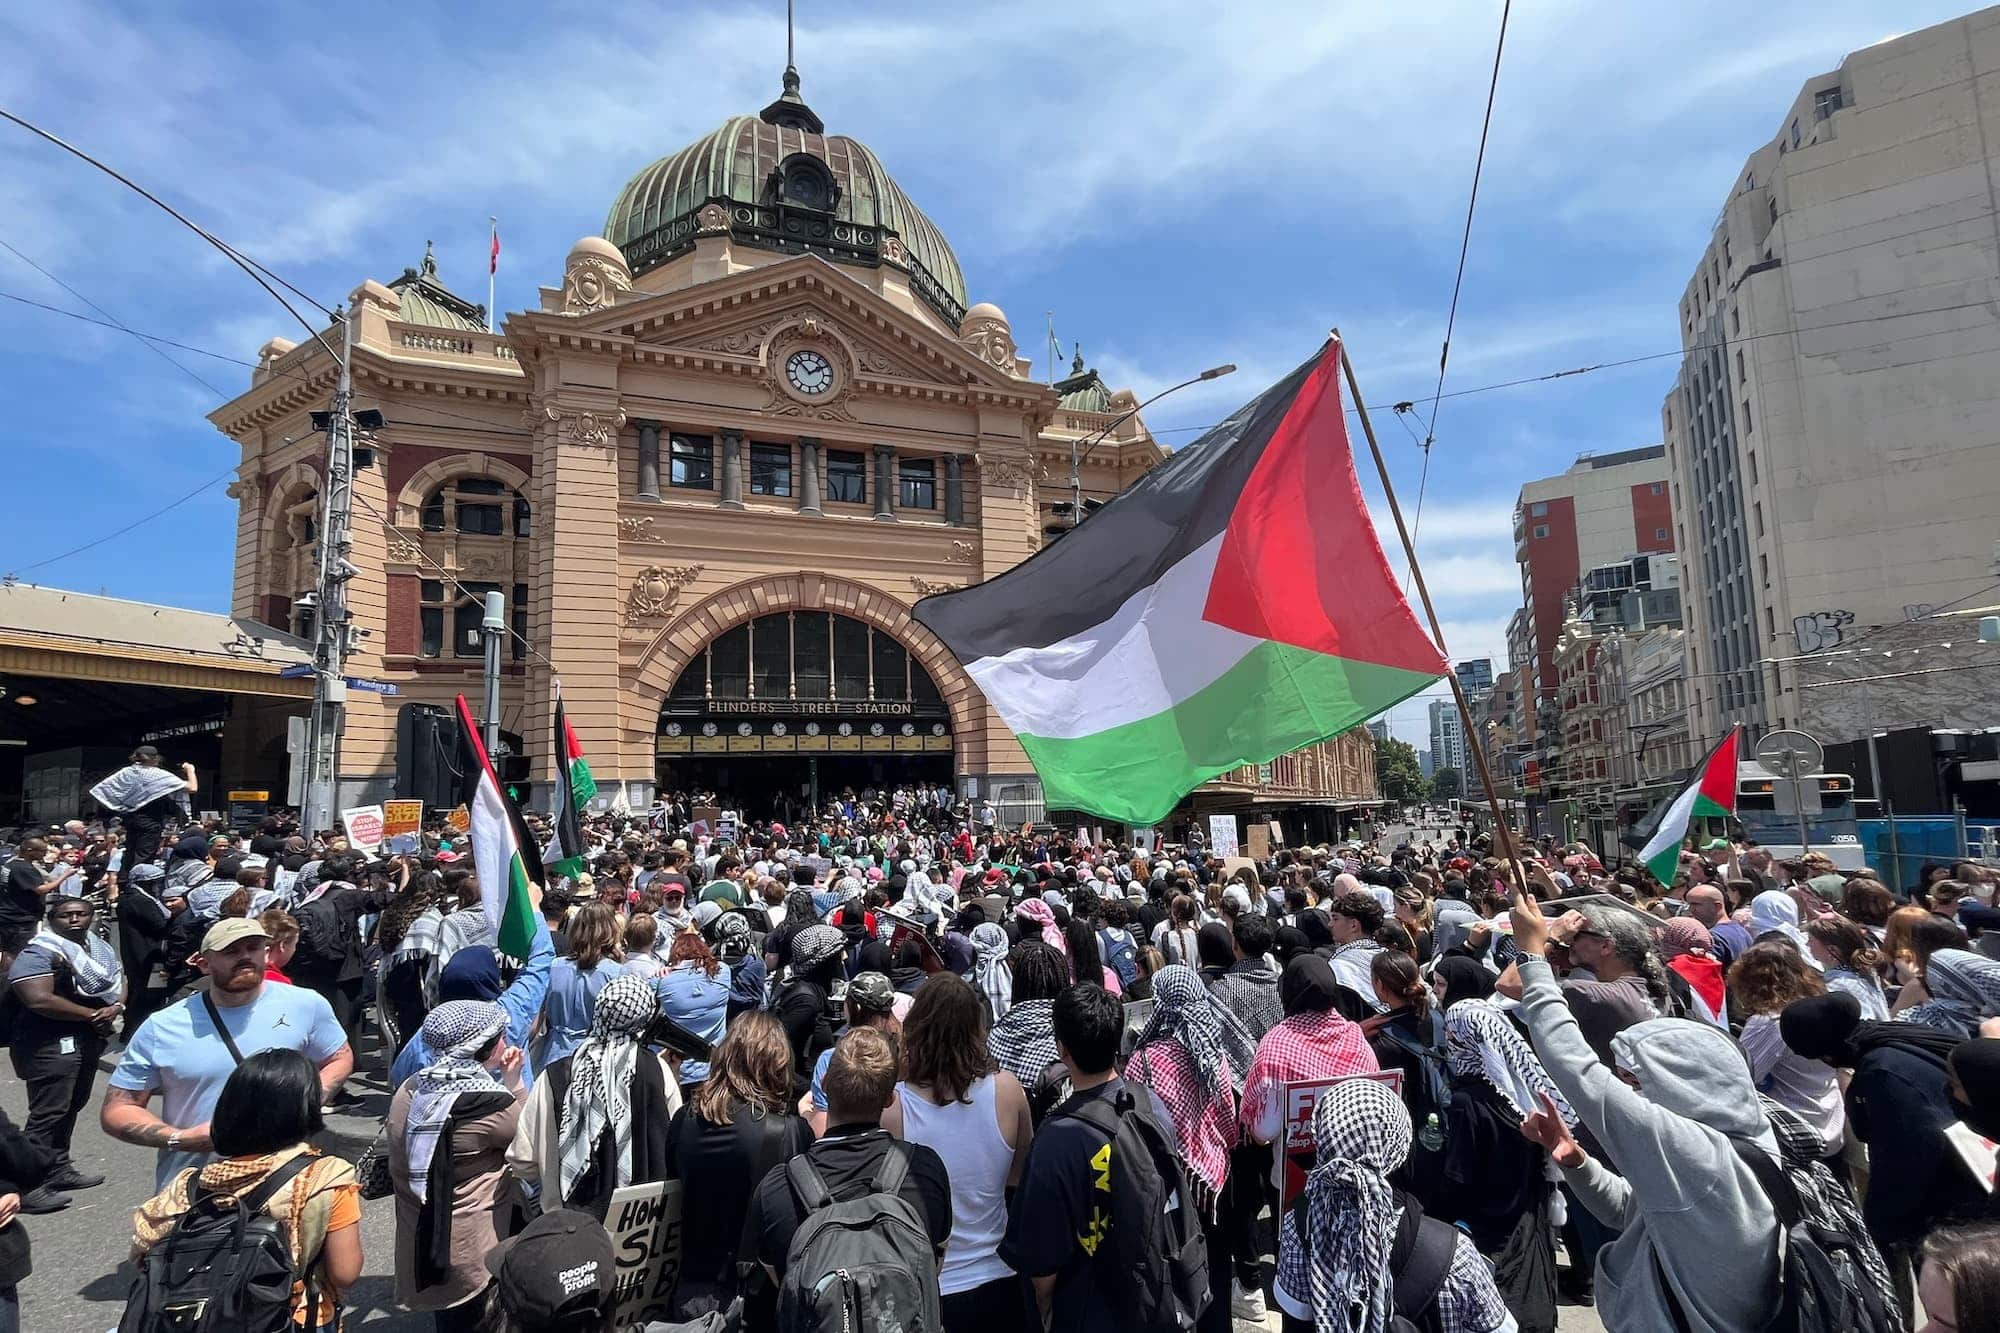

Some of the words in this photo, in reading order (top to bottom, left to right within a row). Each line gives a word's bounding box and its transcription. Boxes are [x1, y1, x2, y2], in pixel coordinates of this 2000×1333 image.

[708, 701, 775, 713] FLINDERS
[792, 702, 840, 714] STREET
[855, 703, 911, 715] STATION
[1830, 834, 1857, 844] 2050
[617, 1193, 668, 1233] HOW
[558, 1261, 598, 1283] people
[564, 1273, 597, 1295] profit
